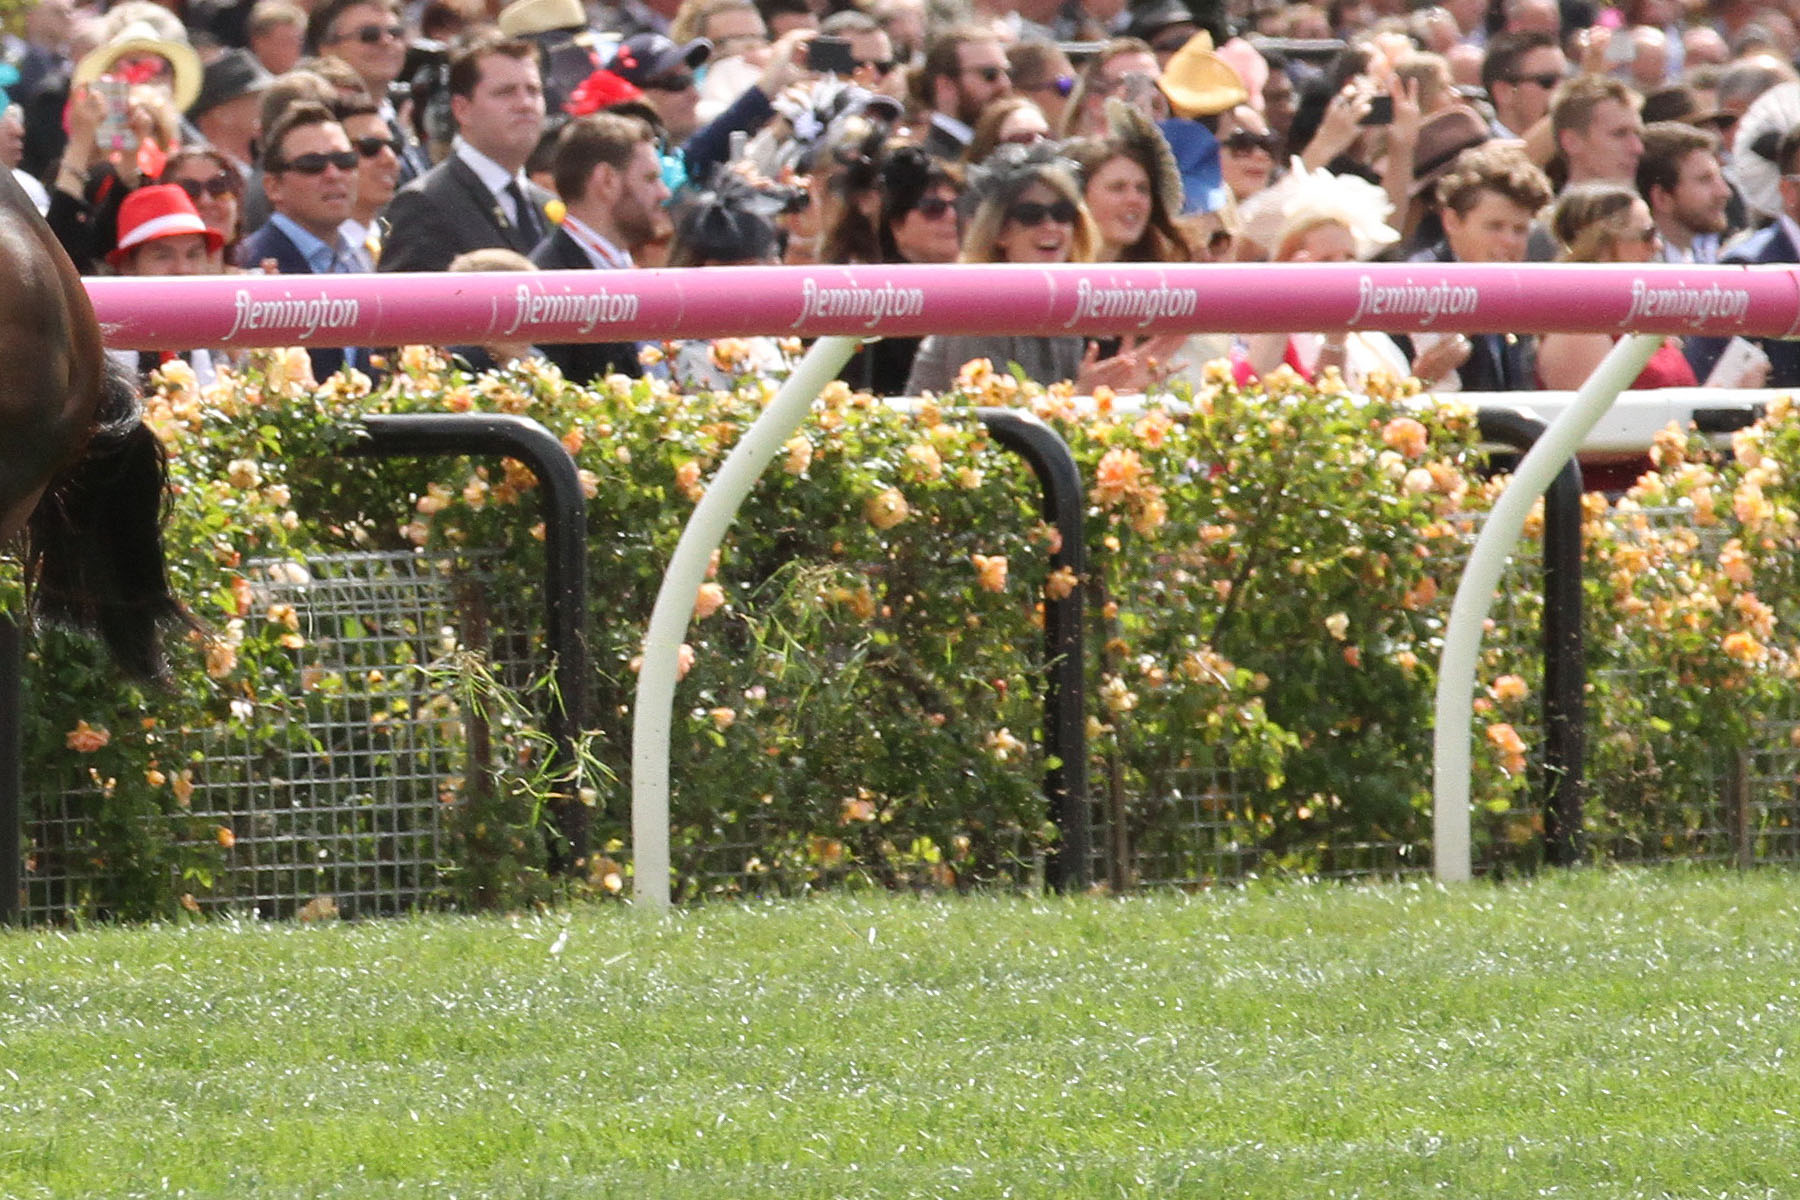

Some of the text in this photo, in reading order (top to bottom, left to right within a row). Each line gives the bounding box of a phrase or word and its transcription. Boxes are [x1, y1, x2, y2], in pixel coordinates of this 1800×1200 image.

[222, 290, 360, 341] flemington
[505, 285, 639, 337] flemington
[792, 277, 924, 329] flemington
[1064, 275, 1198, 330] flemington
[1348, 275, 1479, 326] flemington
[1618, 278, 1751, 328] flemington
